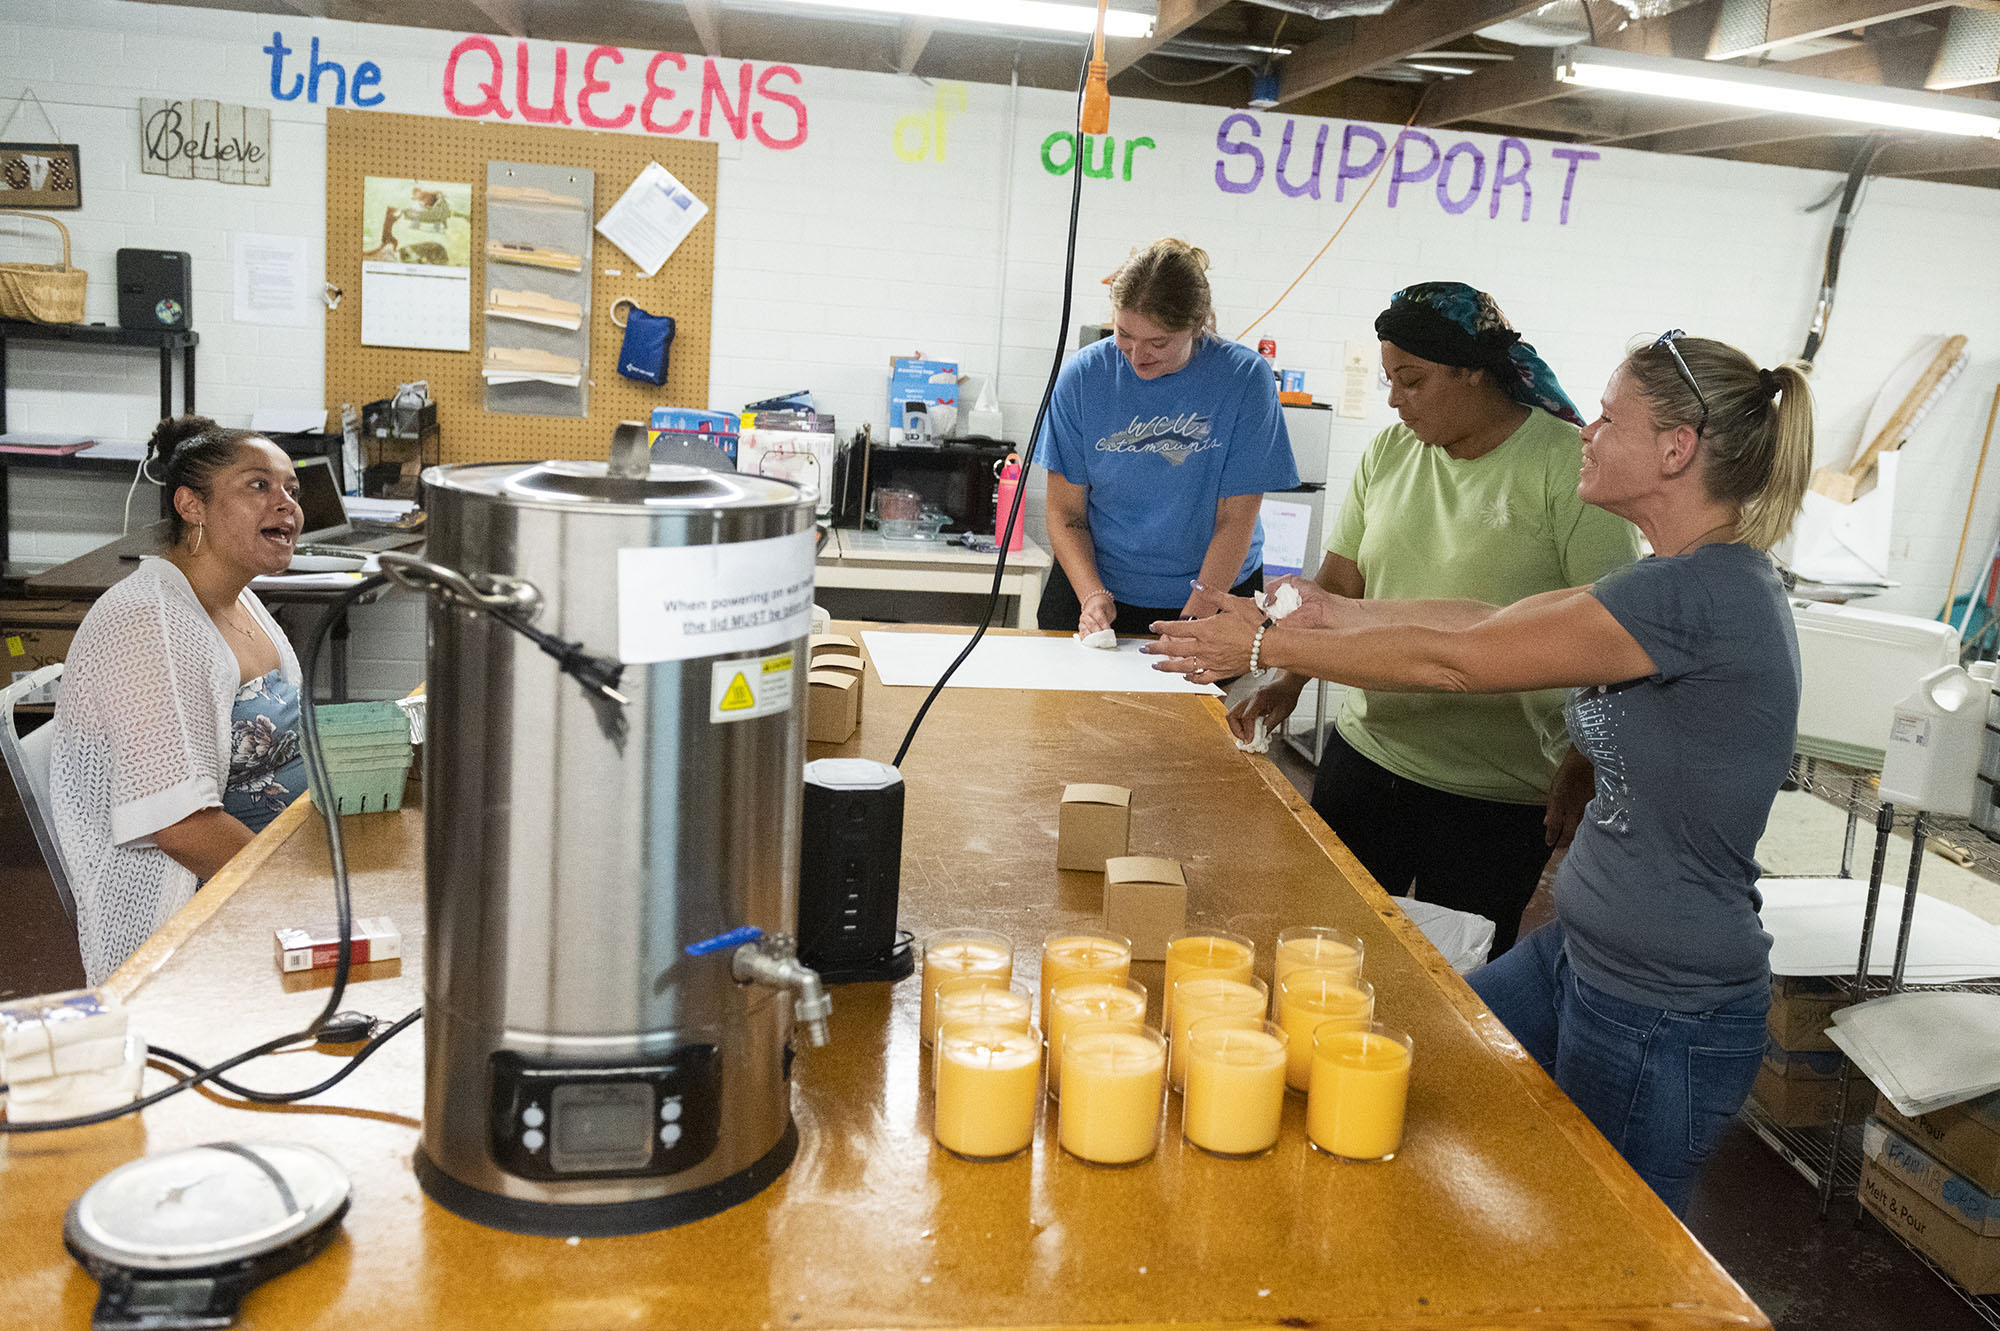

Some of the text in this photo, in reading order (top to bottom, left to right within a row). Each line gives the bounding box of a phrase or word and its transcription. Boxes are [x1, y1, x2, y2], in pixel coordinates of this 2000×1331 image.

[263, 31, 1600, 226] the QUEENS of our SUPPORT
[1127, 412, 1200, 437] WCU
[1095, 437, 1223, 453] Catamounts
[664, 599, 708, 612] When
[711, 593, 769, 613] powering
[683, 620, 706, 636] the
[710, 617, 728, 632] lid
[732, 610, 766, 628] MUST
[1919, 1115, 1946, 1142] Pour
[1865, 1177, 1888, 1206] Melt
[1888, 1197, 1900, 1216] &
[1899, 1205, 1927, 1235] Pour
